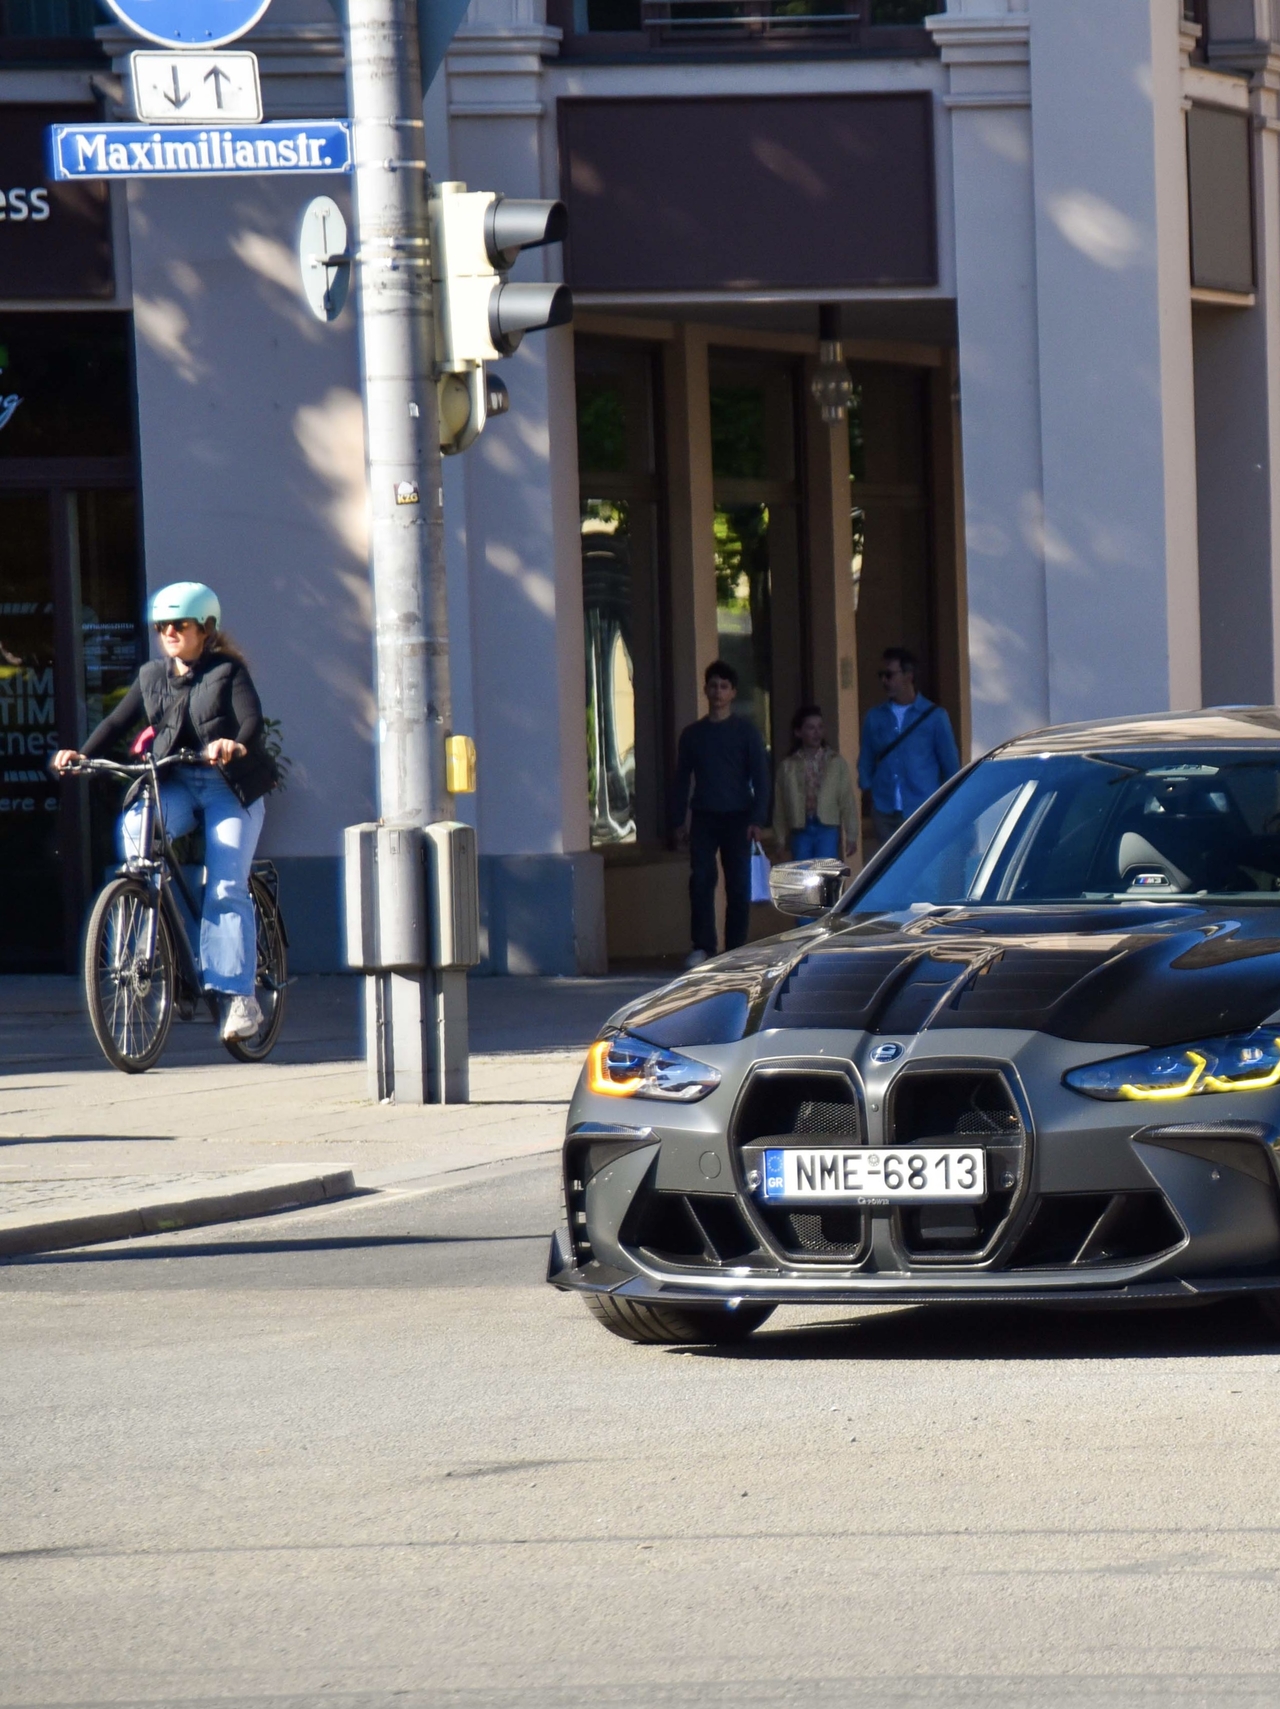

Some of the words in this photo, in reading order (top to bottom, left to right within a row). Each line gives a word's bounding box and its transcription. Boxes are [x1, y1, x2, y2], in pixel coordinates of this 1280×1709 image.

[75, 131, 332, 171] Maximilianstr.
[767, 1177, 784, 1188] GR
[796, 1153, 978, 1191] NME-6813
